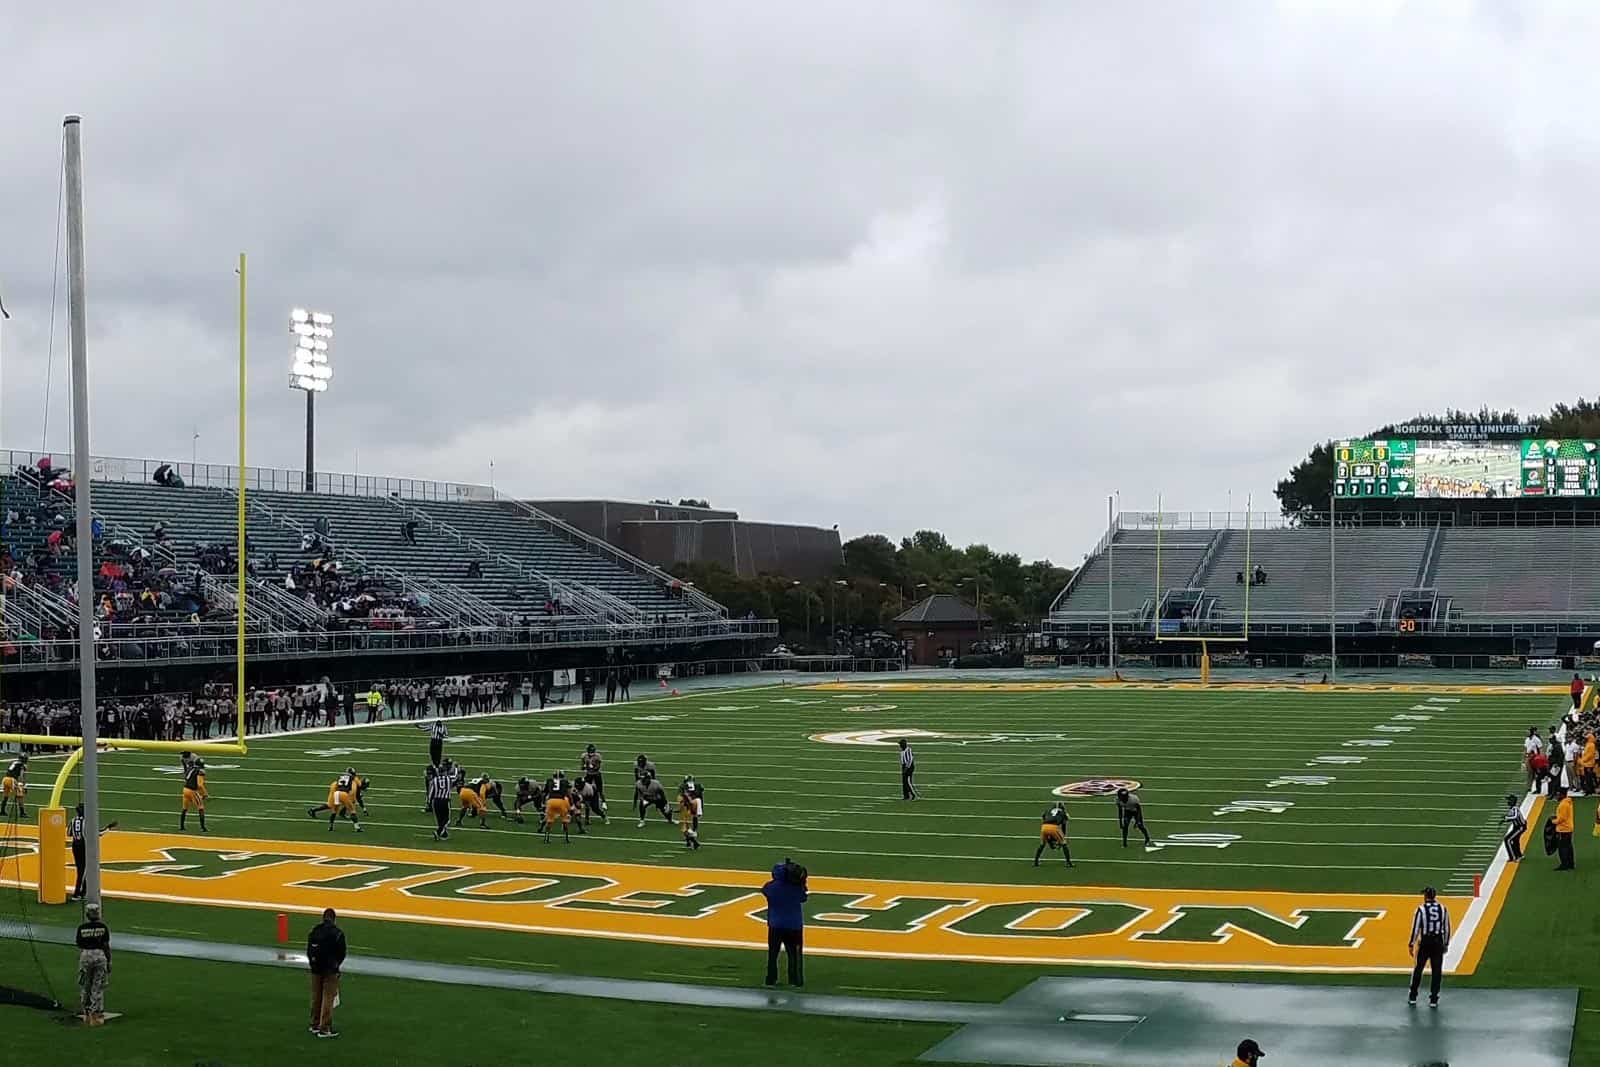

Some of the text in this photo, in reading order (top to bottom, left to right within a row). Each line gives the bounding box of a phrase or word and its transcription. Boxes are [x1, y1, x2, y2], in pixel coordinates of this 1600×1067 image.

[1394, 425, 1442, 434] NORFOLK
[1445, 425, 1476, 434] STATE
[1400, 620, 1415, 632] 20
[1428, 906, 1440, 921] S
